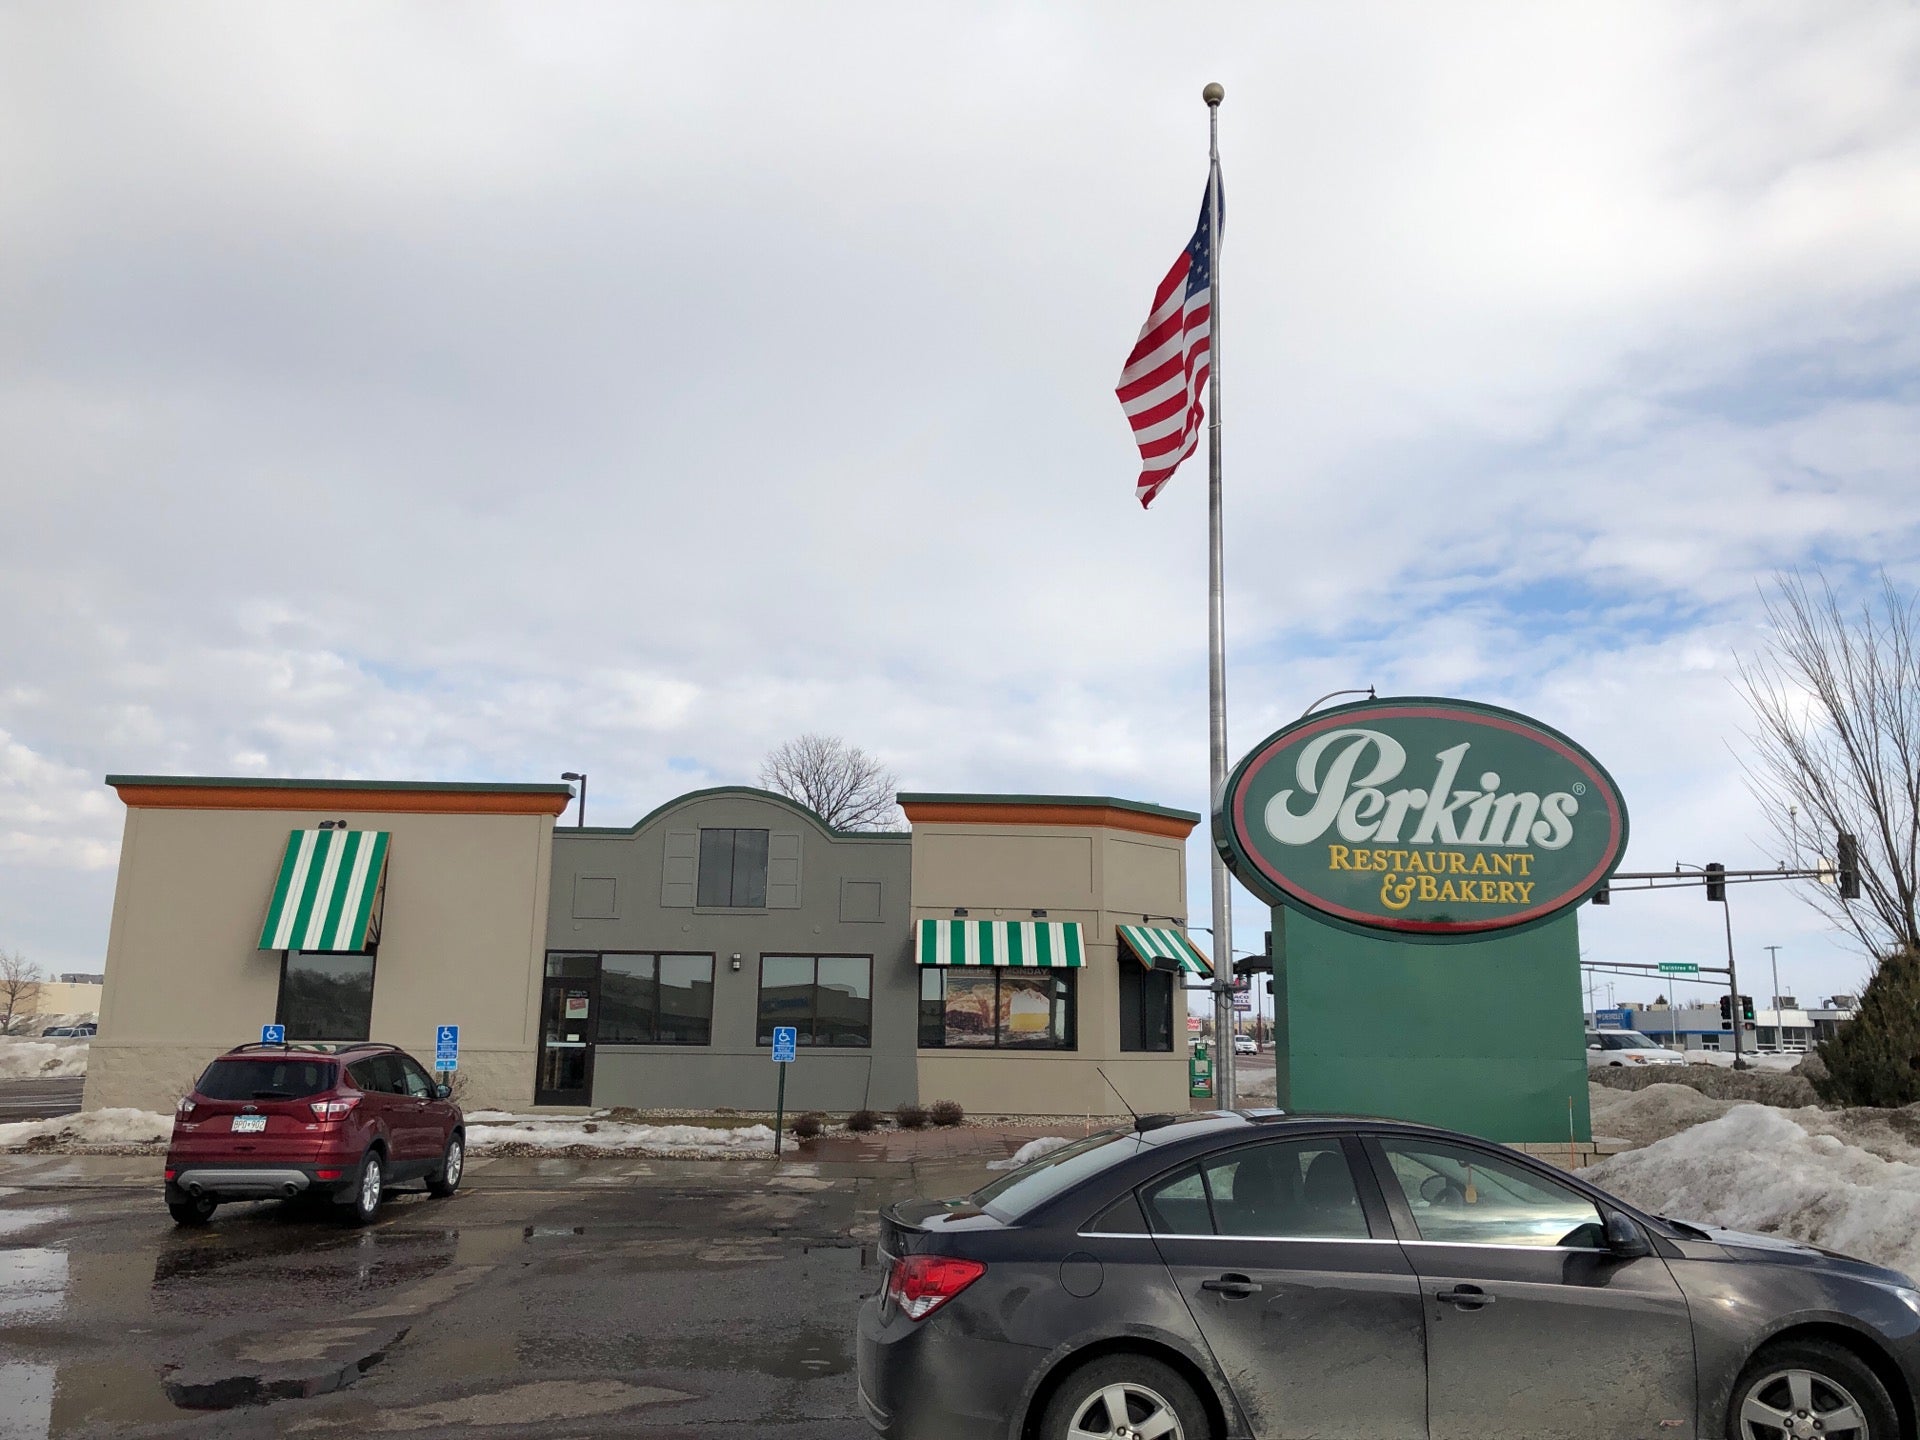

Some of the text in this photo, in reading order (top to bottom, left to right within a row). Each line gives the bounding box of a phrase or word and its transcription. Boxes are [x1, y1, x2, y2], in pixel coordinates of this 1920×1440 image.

[1264, 730, 1578, 849] Perkins
[1329, 844, 1535, 876] RESTAURANT
[1003, 967, 1048, 975] MONDAY
